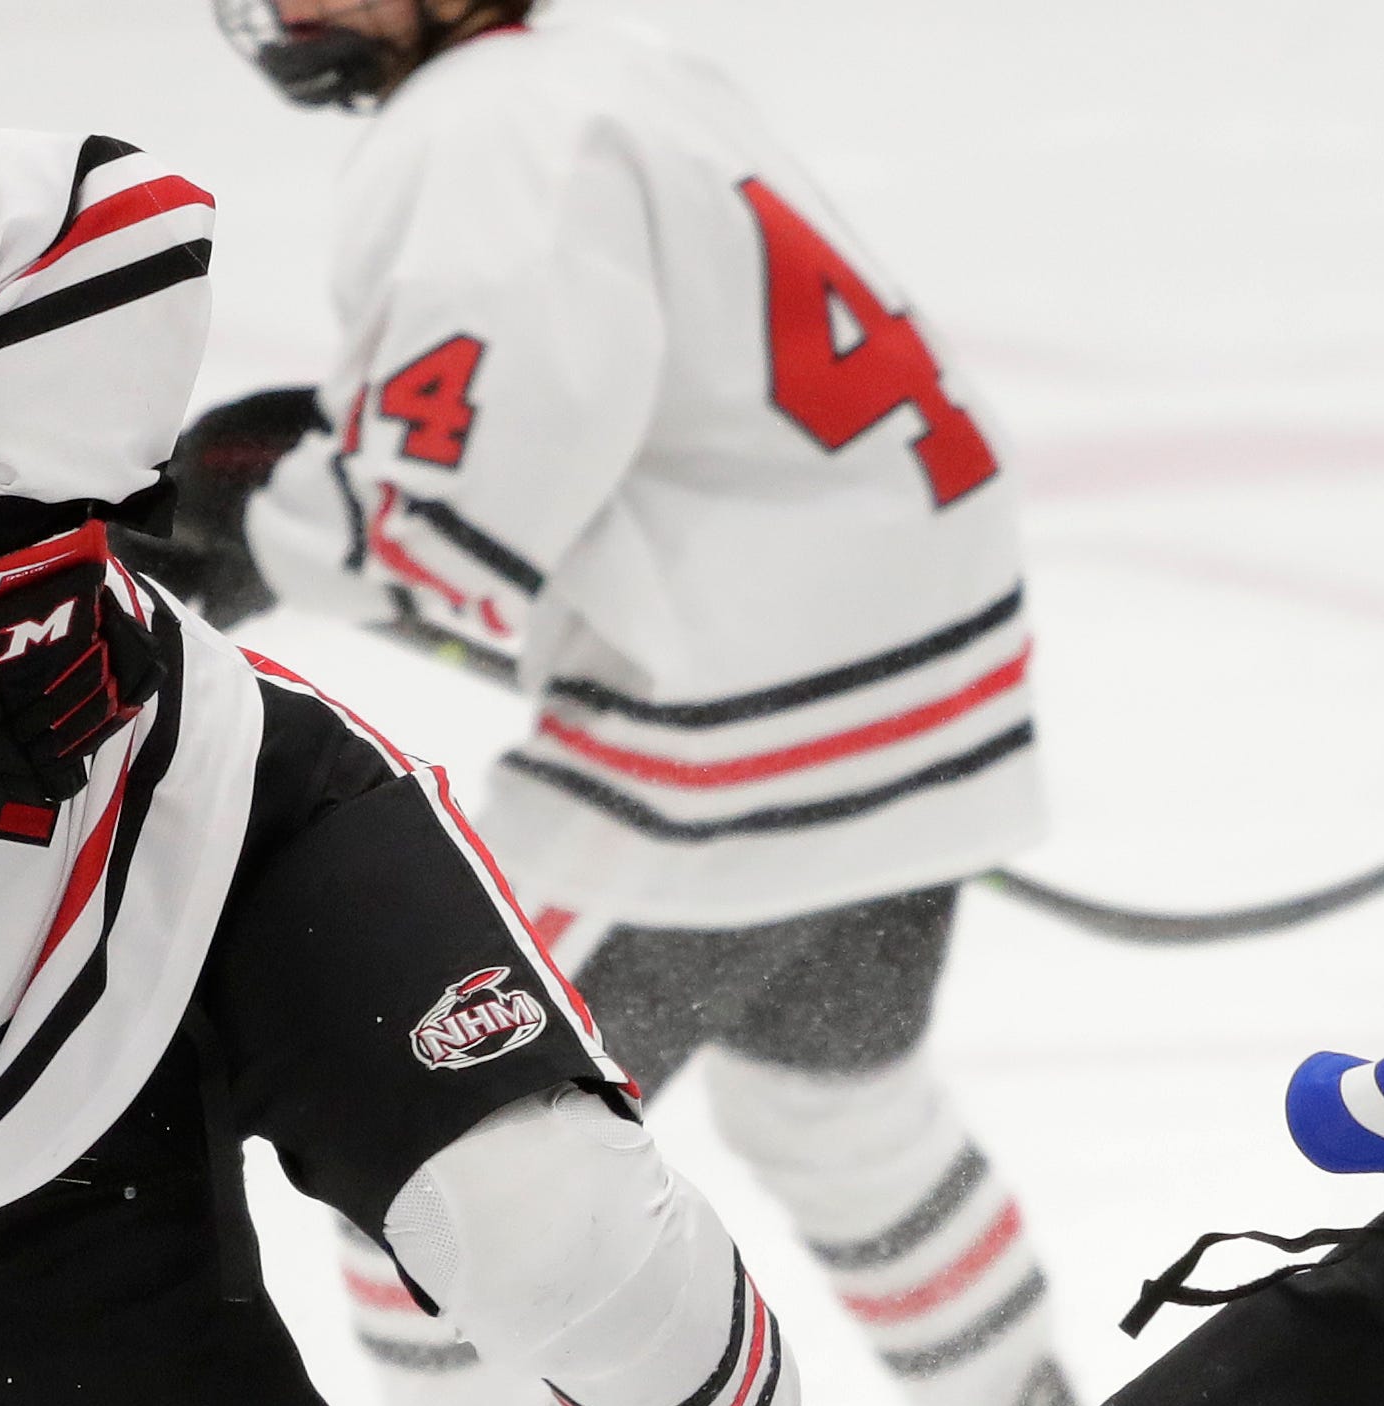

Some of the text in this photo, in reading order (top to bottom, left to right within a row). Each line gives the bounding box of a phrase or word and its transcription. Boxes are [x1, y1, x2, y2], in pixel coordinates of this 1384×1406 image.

[343, 332, 487, 470] 4
[734, 174, 1000, 512] 4
[416, 993, 540, 1063] NHM
